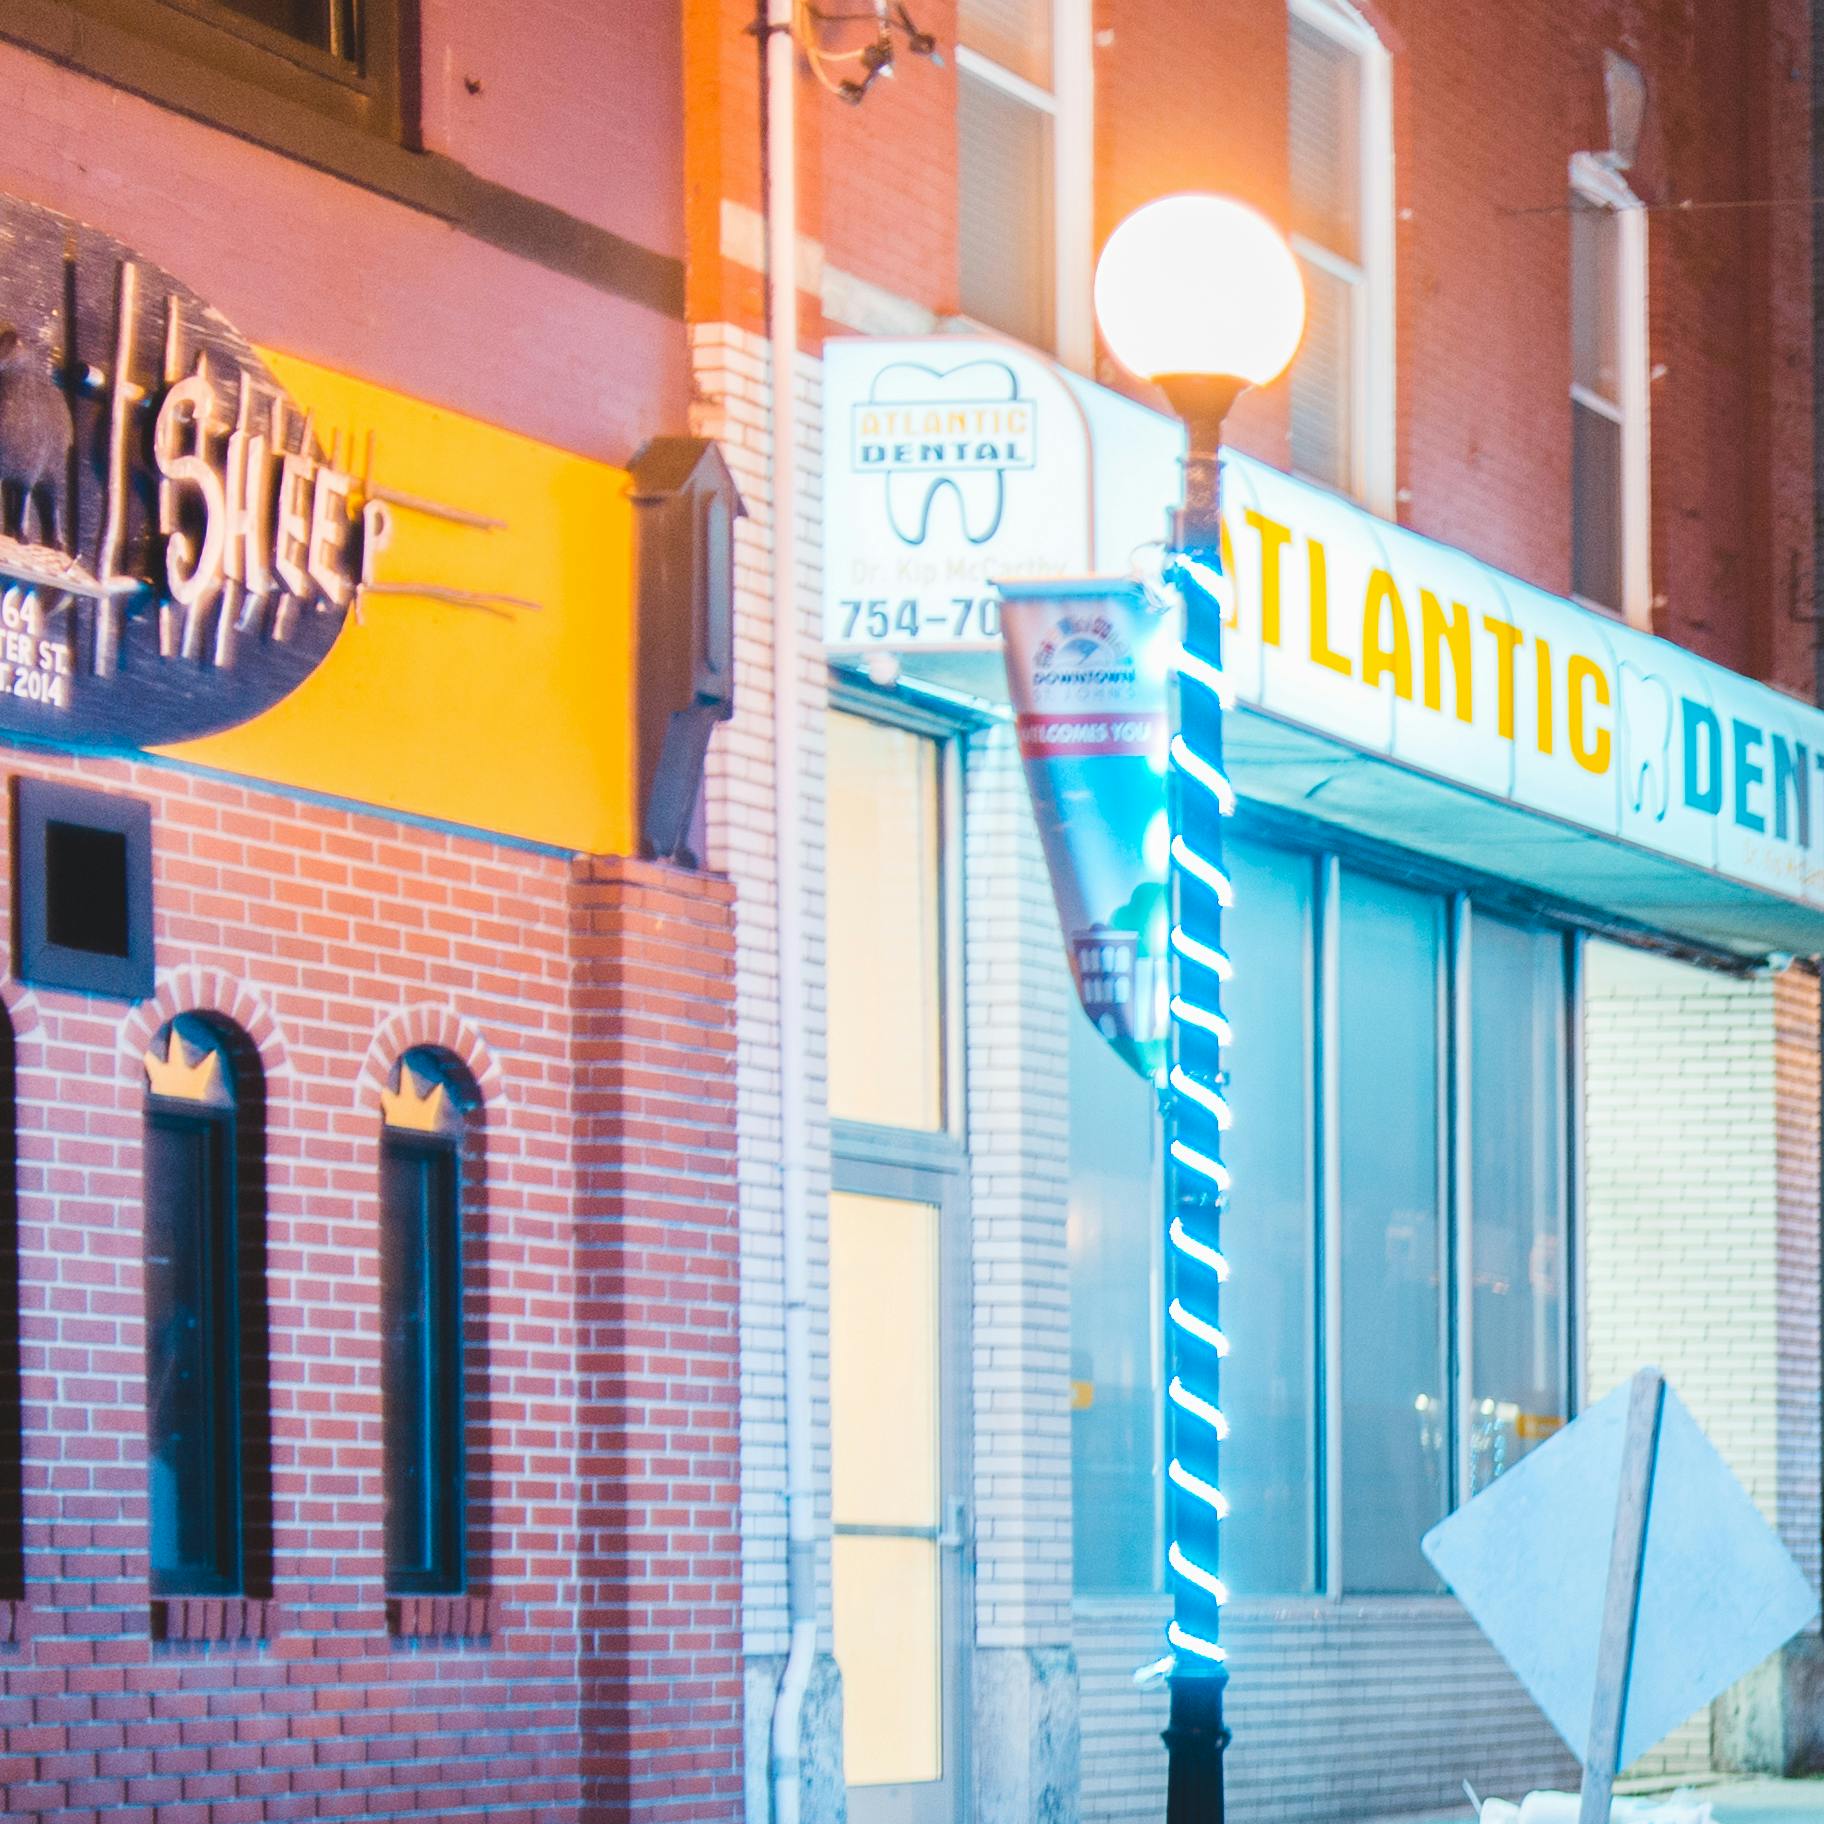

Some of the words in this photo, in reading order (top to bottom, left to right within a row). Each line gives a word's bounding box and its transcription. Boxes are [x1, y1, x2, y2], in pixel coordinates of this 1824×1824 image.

[860, 408, 1027, 437] ATLANTIC
[860, 441, 1025, 463] DENTAL
[155, 374, 393, 608] SHEEP
[897, 556, 931, 585] Kip
[39, 640, 70, 675] ST.
[14, 667, 62, 707] 2014
[1033, 668, 1137, 686] DOWNTOWN
[1111, 721, 1152, 743] YOU
